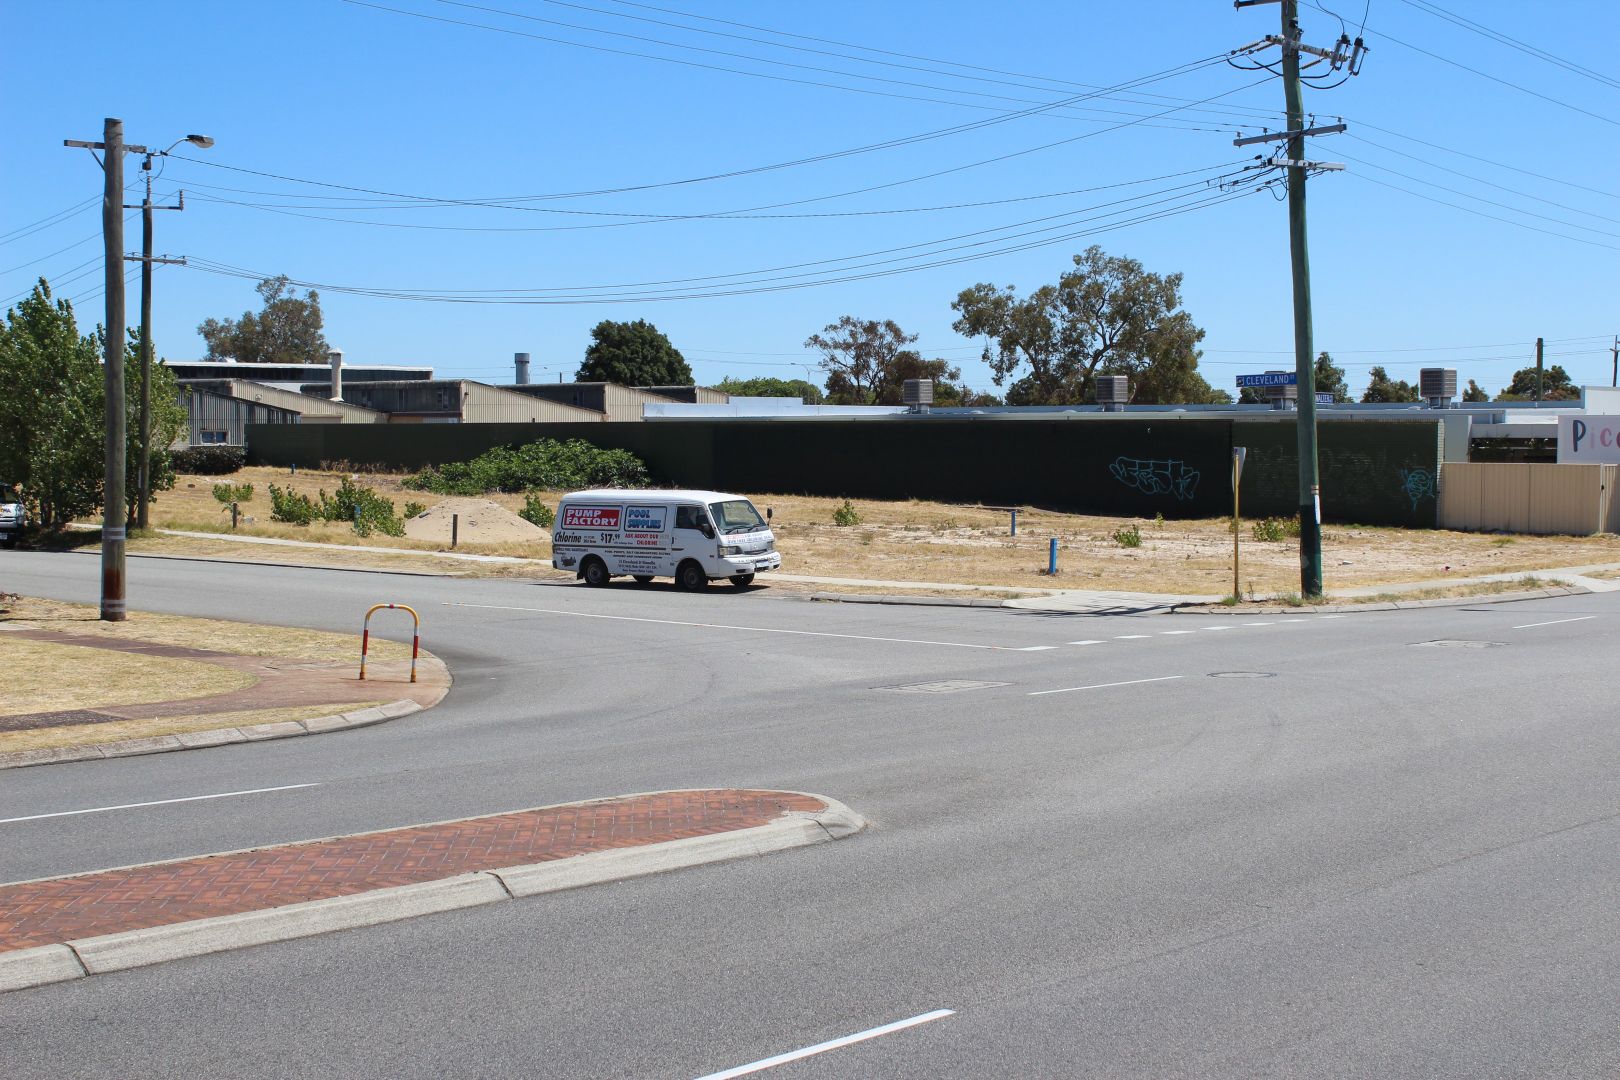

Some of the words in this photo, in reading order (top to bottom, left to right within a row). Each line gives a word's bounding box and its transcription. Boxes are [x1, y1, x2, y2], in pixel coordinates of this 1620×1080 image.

[1246, 375, 1289, 385] CLEVELAND
[1572, 419, 1620, 452] Pic
[567, 509, 602, 518] PUMP
[628, 509, 650, 518] POOL
[566, 517, 617, 526] FACTORY
[627, 518, 661, 529] SUPPLIES
[554, 531, 582, 543] Chlorine
[600, 532, 621, 544] $17.99
